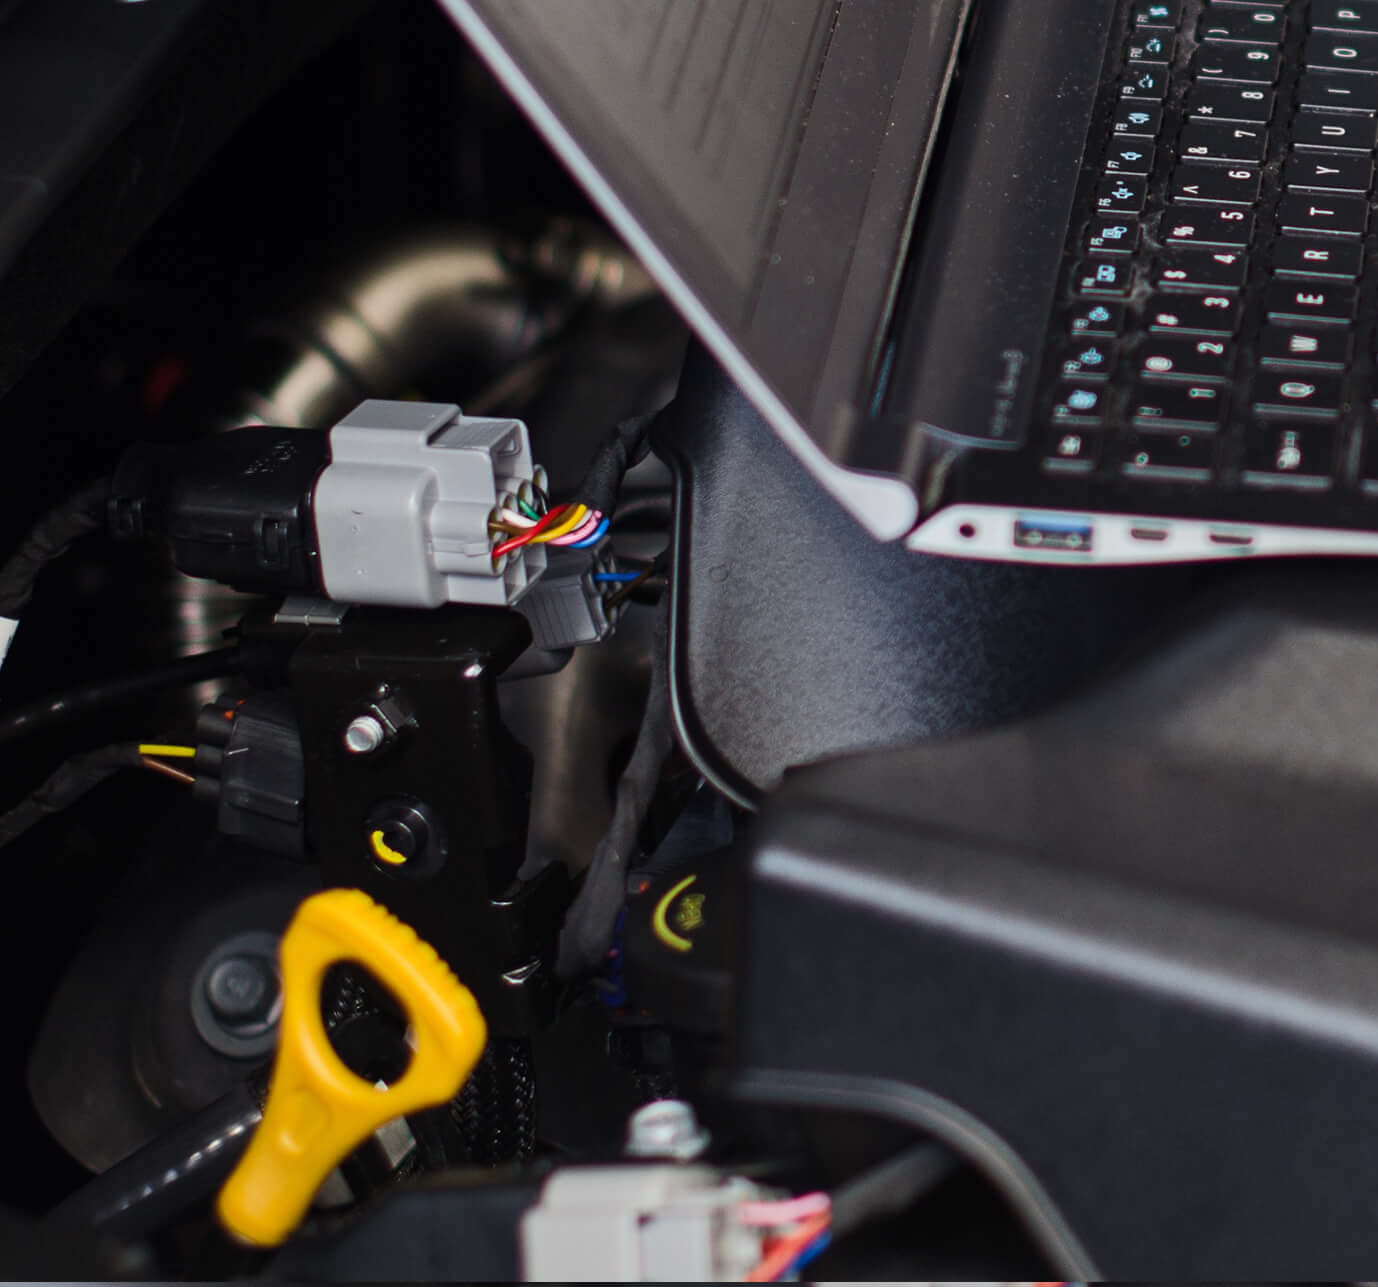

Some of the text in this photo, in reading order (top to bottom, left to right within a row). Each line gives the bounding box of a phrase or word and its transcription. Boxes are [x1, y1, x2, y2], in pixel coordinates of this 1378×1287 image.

[1333, 48, 1357, 57] O
[1322, 126, 1345, 135] U
[1316, 166, 1339, 174] Y
[1309, 207, 1333, 215] T
[1221, 212, 1243, 220] 5
[1214, 255, 1235, 264] 4
[1304, 250, 1328, 260] R
[1204, 297, 1229, 308] 3
[1296, 294, 1323, 304] E
[1197, 342, 1223, 354] 2
[1291, 336, 1317, 352] W
[1280, 383, 1314, 397] Q
